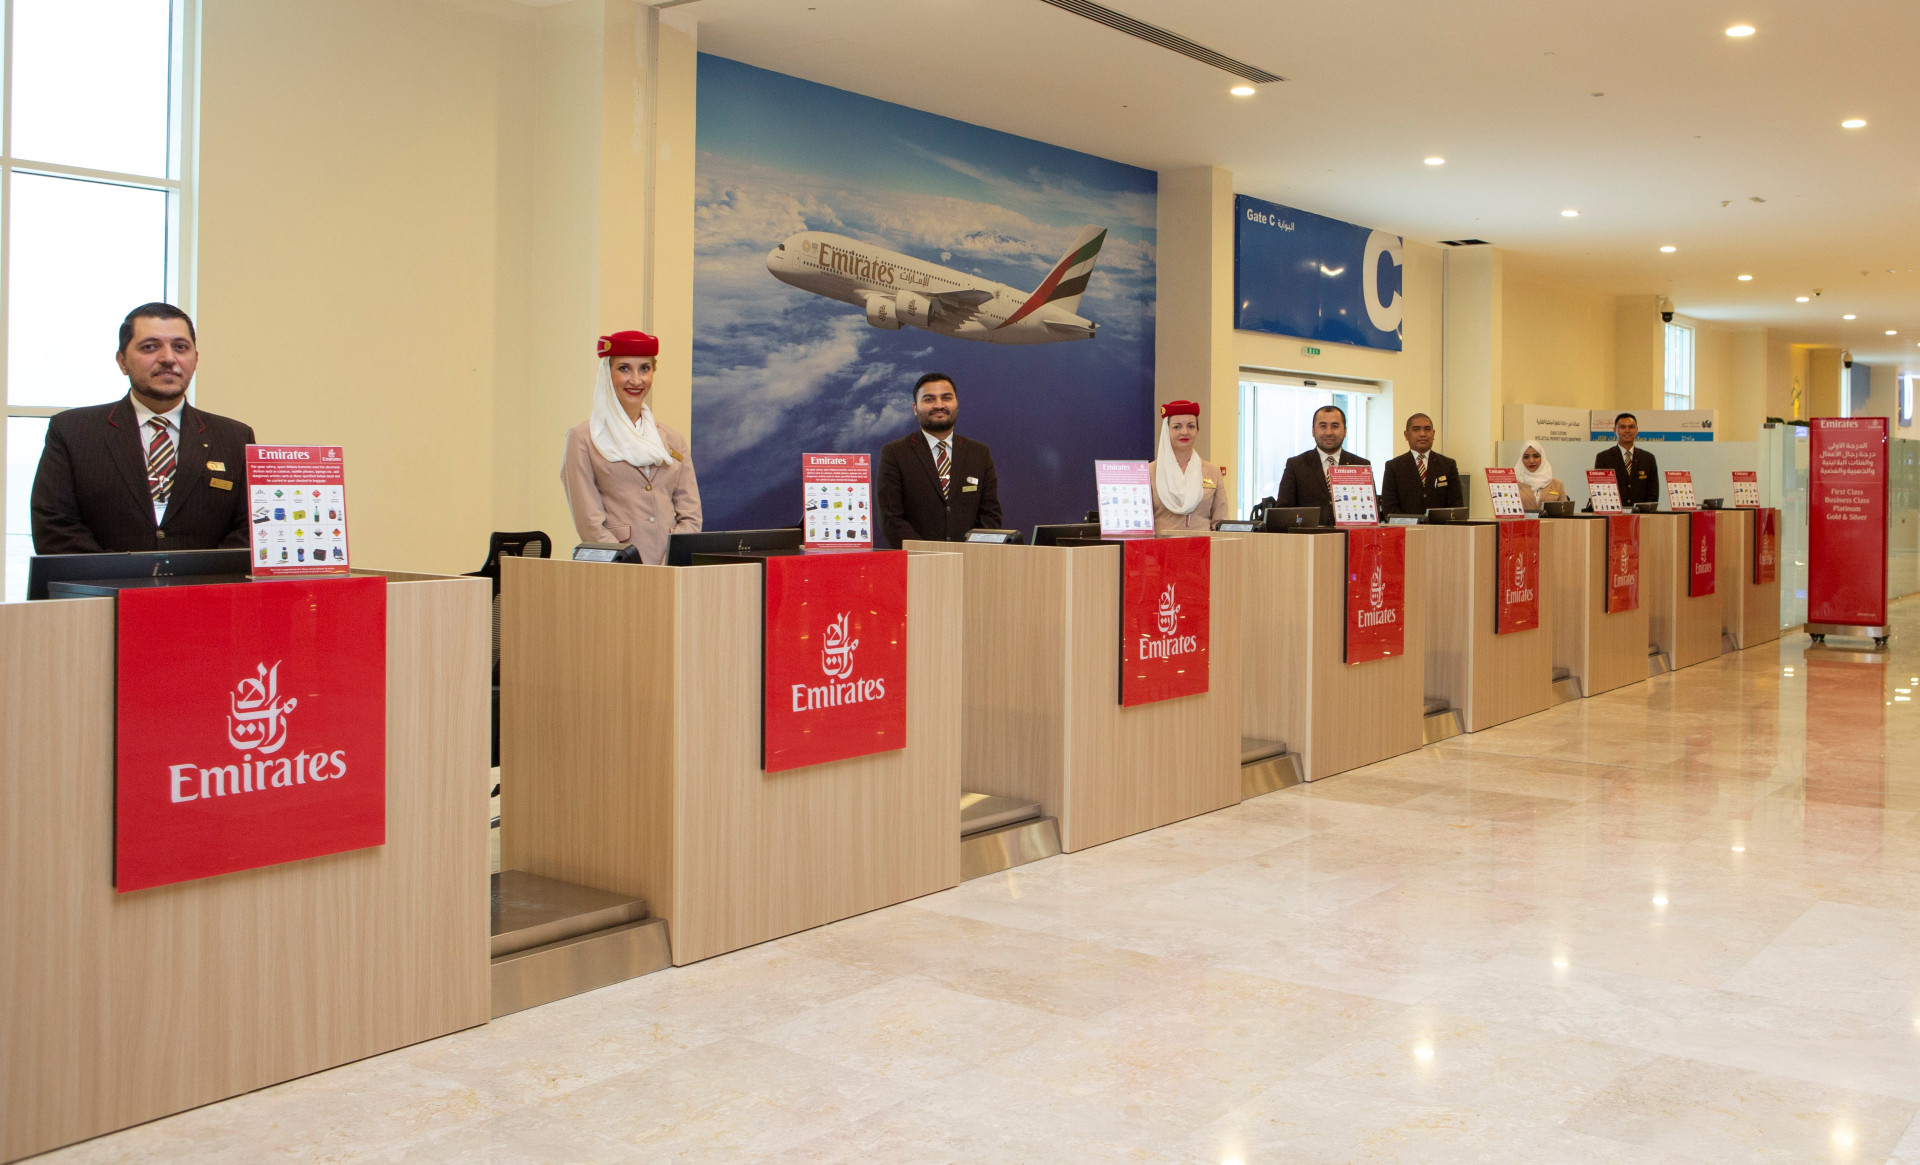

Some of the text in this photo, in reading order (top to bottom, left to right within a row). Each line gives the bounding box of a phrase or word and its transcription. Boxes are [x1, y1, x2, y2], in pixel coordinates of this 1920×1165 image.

[1246, 208, 1275, 226] Gate C
[819, 242, 895, 285] Emirates
[1363, 229, 1402, 332] C
[1820, 420, 1859, 429] Emirates
[257, 448, 310, 460] Emirates
[810, 456, 847, 465] Emirates
[1102, 463, 1131, 471] Emirates
[1613, 573, 1635, 588] Emirates
[1506, 587, 1534, 605] Emirates
[1357, 607, 1396, 628] Emirates
[1139, 634, 1197, 661] Emirates
[791, 677, 886, 712] Emirates
[168, 749, 347, 804] Emirates
